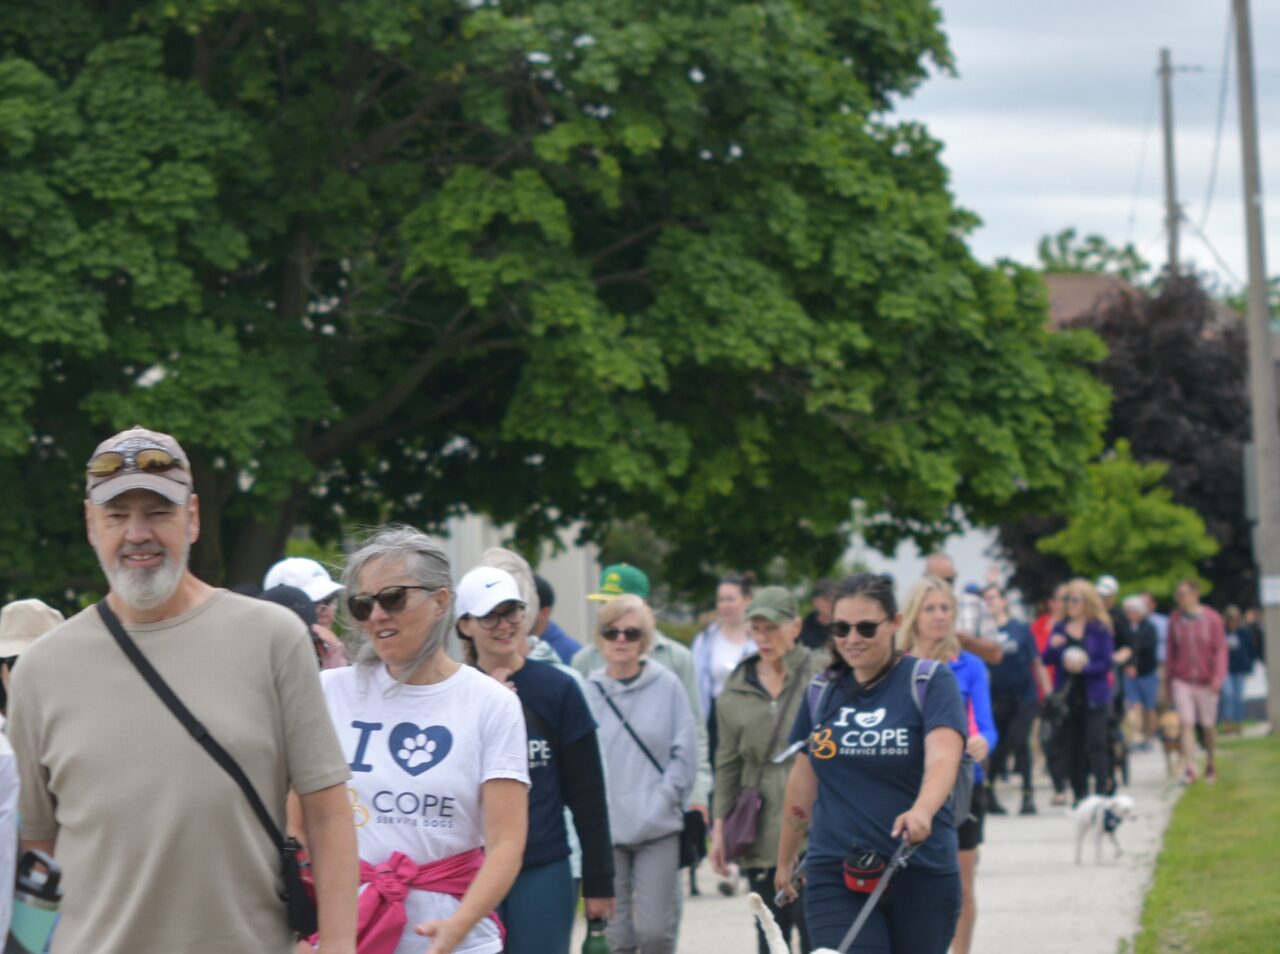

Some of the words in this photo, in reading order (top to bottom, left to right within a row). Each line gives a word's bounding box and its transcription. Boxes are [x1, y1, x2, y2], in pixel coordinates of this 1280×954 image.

[833, 707, 856, 727] I
[350, 720, 383, 773] I
[841, 728, 909, 747] COPE
[528, 739, 551, 760] PE
[839, 747, 877, 755] SERVICE
[880, 747, 909, 755] DOGS
[372, 790, 456, 817] COPE
[376, 815, 418, 827] SERVICE
[423, 819, 453, 828] DOGS
